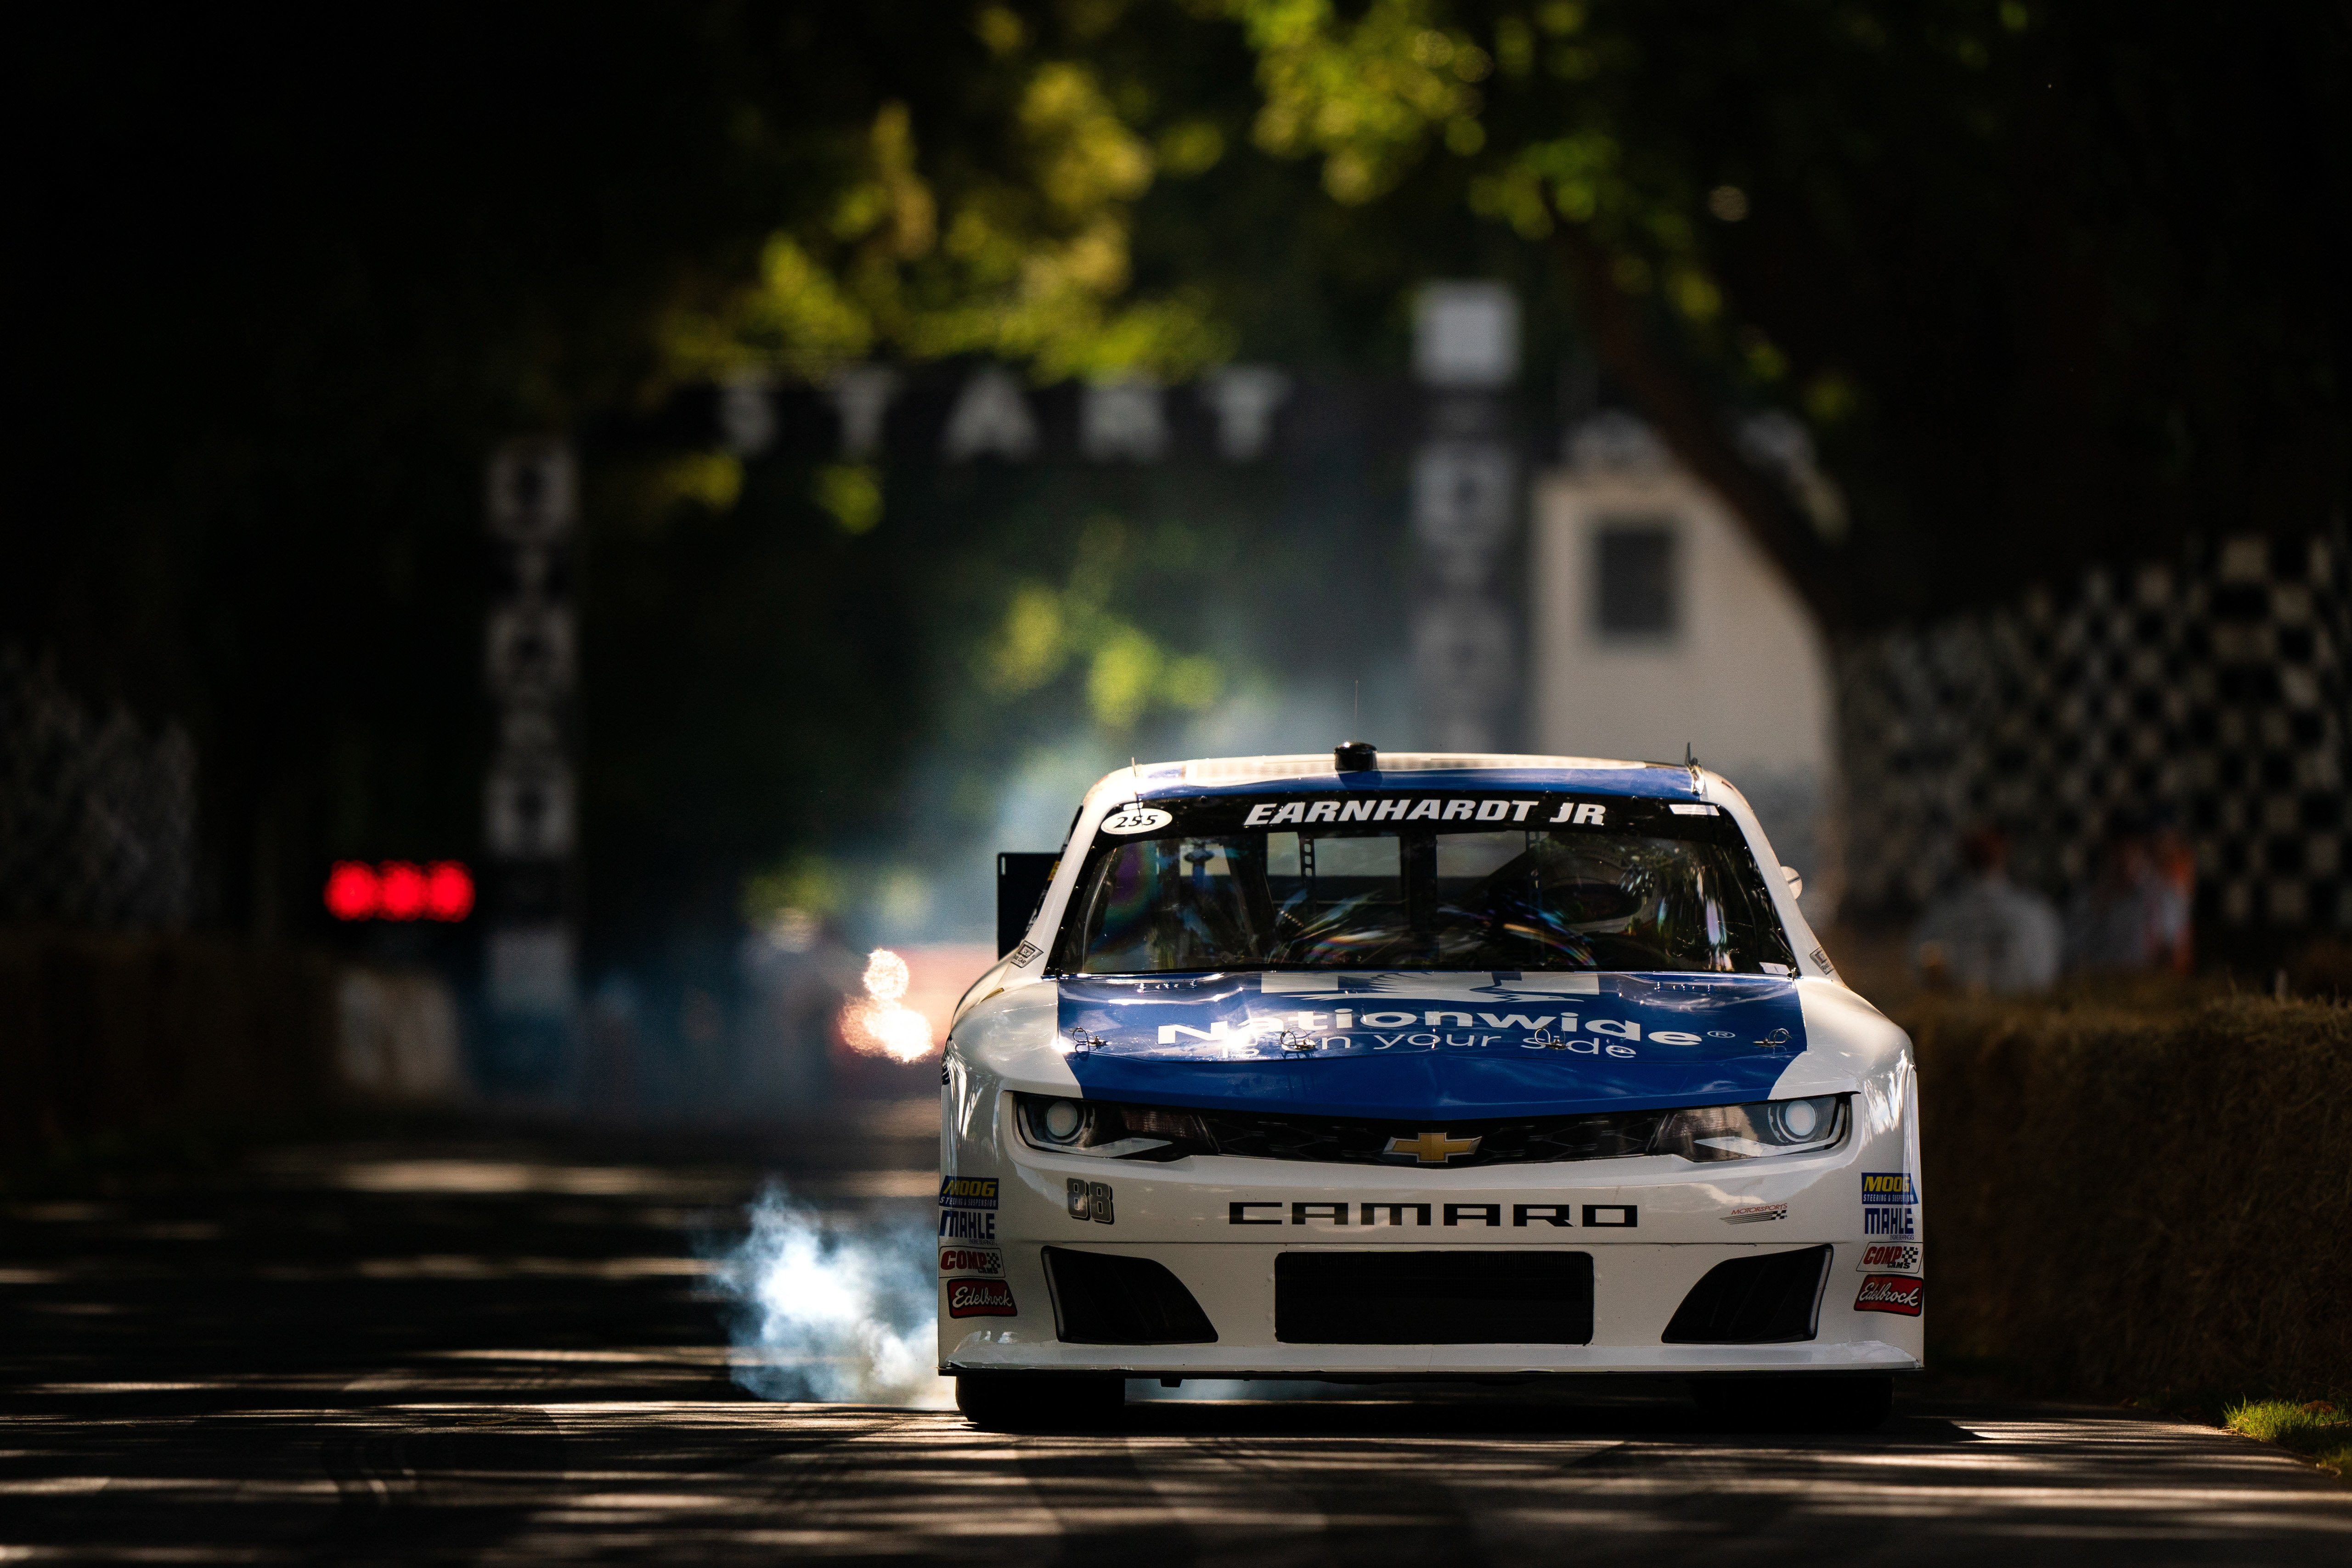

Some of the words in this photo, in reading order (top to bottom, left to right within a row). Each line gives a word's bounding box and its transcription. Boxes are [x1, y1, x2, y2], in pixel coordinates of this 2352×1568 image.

[716, 365, 1293, 459] START
[1113, 815, 1158, 829] 255
[1243, 799, 1538, 826] EARNHARDT
[1549, 802, 1606, 826] JR
[1158, 1008, 1702, 1046] Nationwide
[1373, 1033, 1502, 1049] your
[1520, 1035, 1637, 1058] side
[942, 1179, 997, 1197] MOOG
[1863, 1176, 1911, 1192] MOOG
[968, 1198, 997, 1207] SUSPENSION
[1066, 1177, 1115, 1225] 88
[1731, 1203, 1788, 1215] MOTORSPORTS
[939, 1210, 995, 1240] MAHLE
[1229, 1202, 1638, 1228] CAMARO
[1865, 1208, 1914, 1235] MAHLE
[941, 1250, 987, 1270] COMP
[1863, 1246, 1903, 1265] COMP
[952, 1286, 1012, 1308] Edelbrock
[1858, 1281, 1919, 1307] Edelbrock
